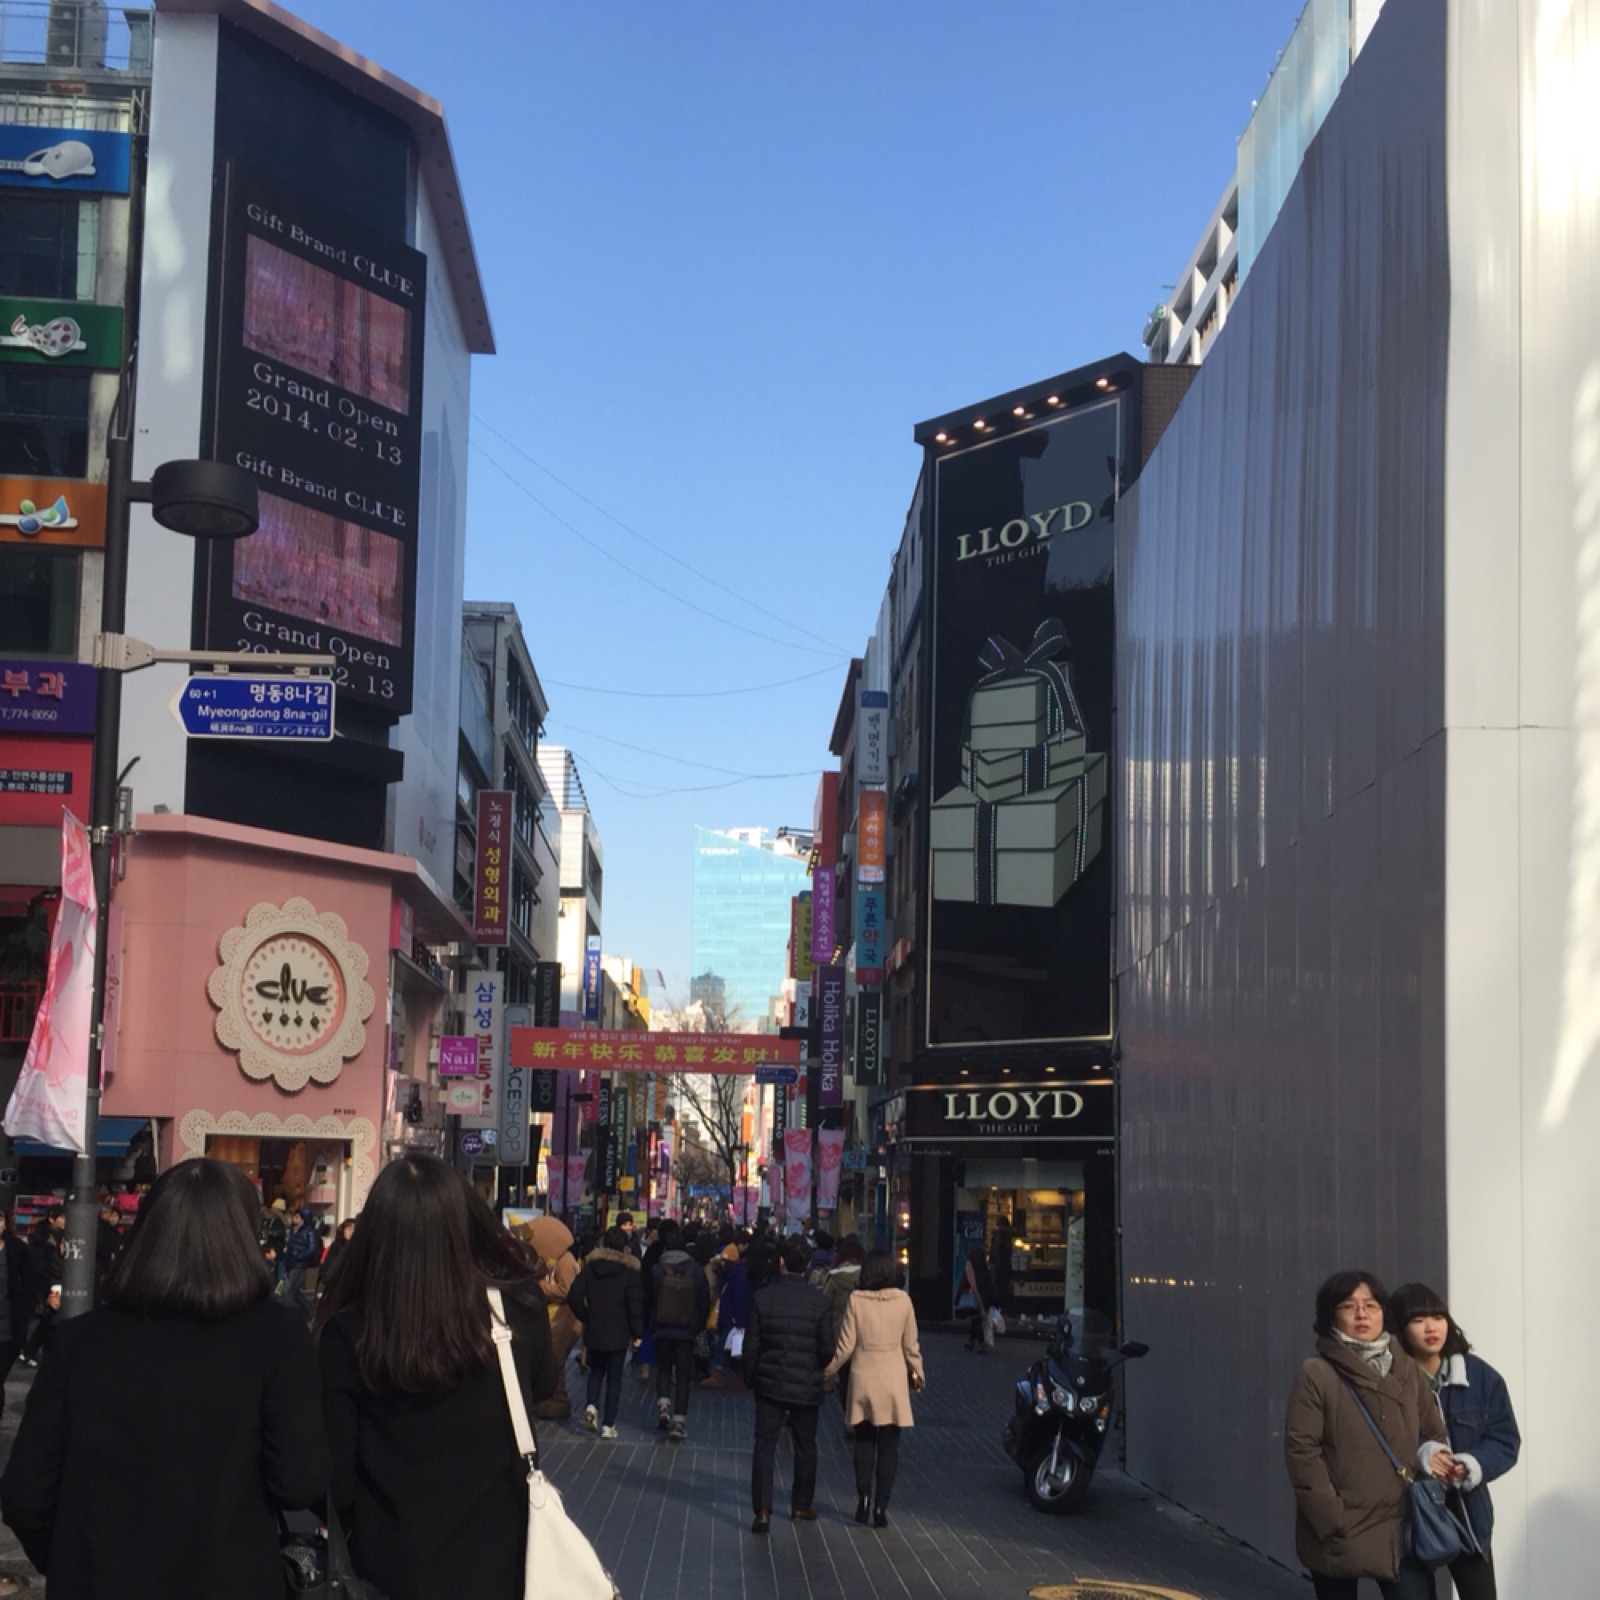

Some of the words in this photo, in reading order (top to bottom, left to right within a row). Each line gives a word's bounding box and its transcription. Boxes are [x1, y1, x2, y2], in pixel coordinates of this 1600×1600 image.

[247, 203, 283, 233] Gift
[290, 224, 347, 264] Brand
[353, 254, 414, 297] CLUE
[253, 361, 330, 409] Grand
[338, 396, 399, 436] Open
[247, 388, 319, 433] 2014.
[327, 421, 364, 451] 02.
[376, 439, 402, 466] 13
[236, 451, 274, 478] Gift
[280, 467, 337, 501] Brand
[345, 491, 406, 526] CLUE
[957, 501, 1093, 561] LLOYD
[986, 551, 1015, 567] THE
[1018, 541, 1053, 558] GIFT
[243, 612, 321, 650] Grand
[329, 637, 390, 670] Open
[197, 705, 280, 720] Myeongdong
[282, 708, 328, 722] 8na-gil
[250, 683, 328, 705] 명동8나길
[367, 676, 395, 699] 13
[483, 847, 502, 924] 성형외과
[821, 981, 841, 1033] Holika
[441, 1052, 475, 1065] Nail
[532, 1041, 643, 1061] 新年快乐
[864, 1007, 877, 1070] LLOYD
[505, 1017, 525, 1153] TACESHOP
[821, 1039, 840, 1092] Holika
[599, 1088, 609, 1127] GUESS
[944, 1090, 1084, 1120] LLOYD
[978, 1124, 1005, 1133] THE
[1008, 1123, 1040, 1133] GIFT
